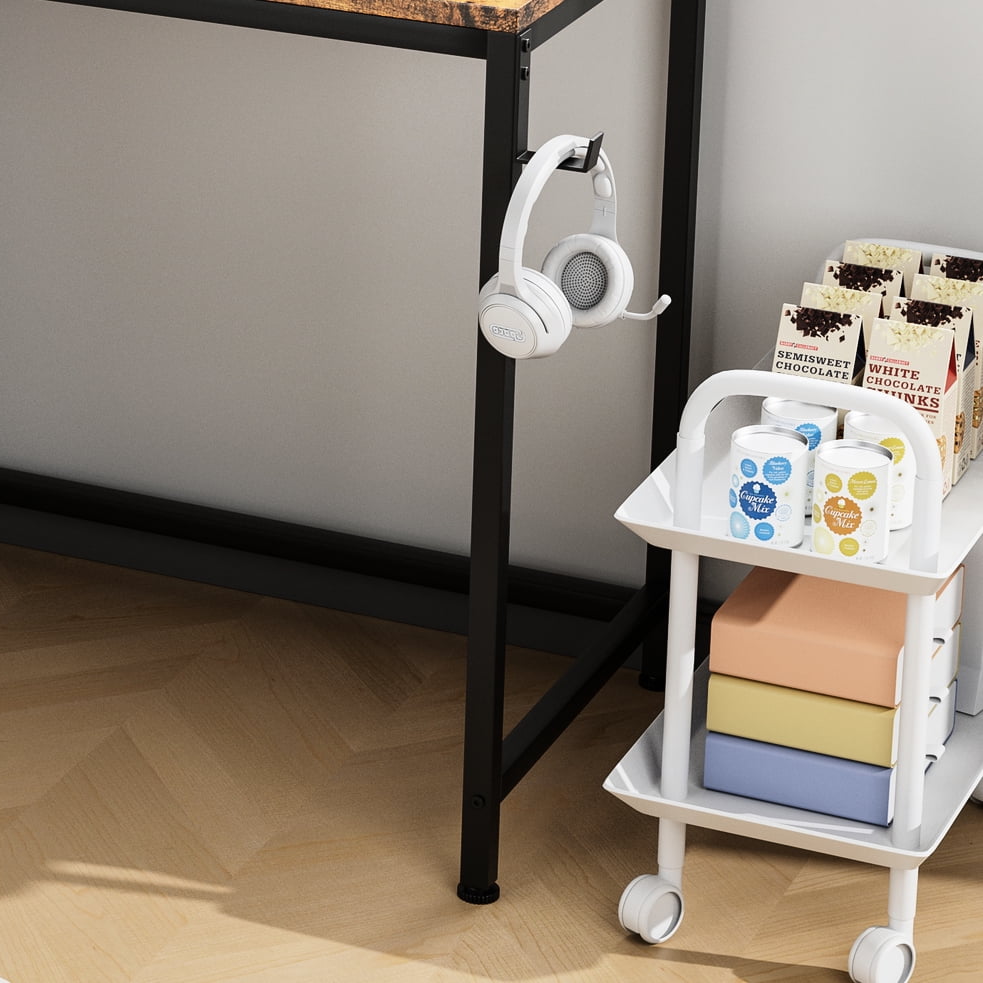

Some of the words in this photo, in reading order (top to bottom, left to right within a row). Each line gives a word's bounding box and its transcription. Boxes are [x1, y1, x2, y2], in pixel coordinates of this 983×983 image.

[777, 350, 851, 369] SEMISWEET
[776, 361, 850, 380] CHOCOLATE
[869, 363, 920, 380] WHITE
[866, 375, 942, 395] CHOCOLATE
[866, 386, 940, 409] NKS
[740, 490, 775, 504] Cupcake
[748, 502, 771, 514] Mix
[824, 505, 859, 519] Cupcake
[832, 517, 856, 529] Mix
